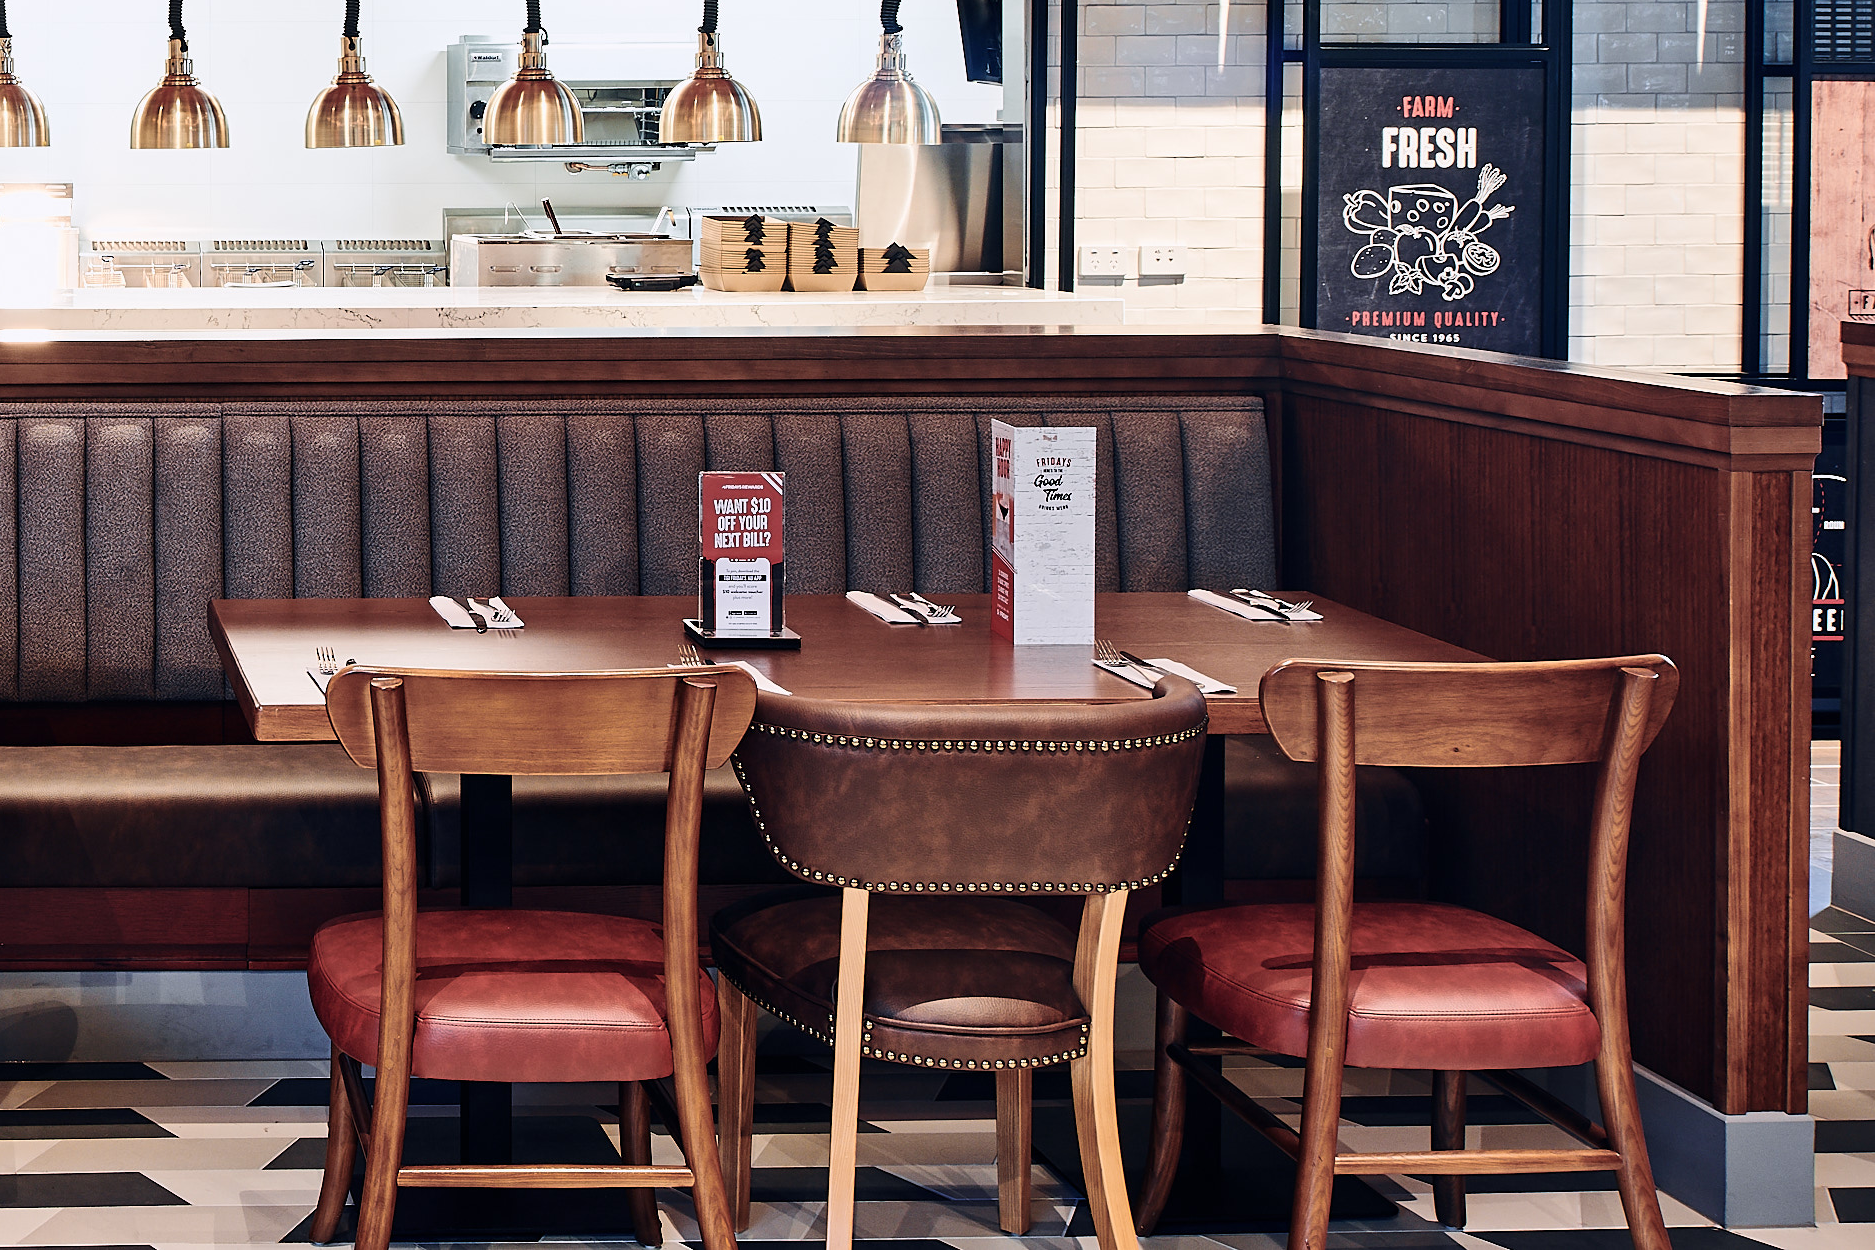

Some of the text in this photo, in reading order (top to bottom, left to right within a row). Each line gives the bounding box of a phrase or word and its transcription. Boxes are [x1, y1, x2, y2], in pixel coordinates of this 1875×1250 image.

[1403, 96, 1454, 118] FARM
[1382, 127, 1477, 169] FRESH
[1352, 311, 1500, 328] PREMIUM QUALITY
[1388, 333, 1460, 343] SINCE 1965
[1036, 457, 1071, 467] FRIDAYS
[1034, 475, 1063, 488] Good
[1043, 488, 1072, 502] Times
[713, 497, 771, 515] WANT $10
[718, 515, 768, 531] OFF YOUR
[714, 532, 771, 548] NEXT BILL?
